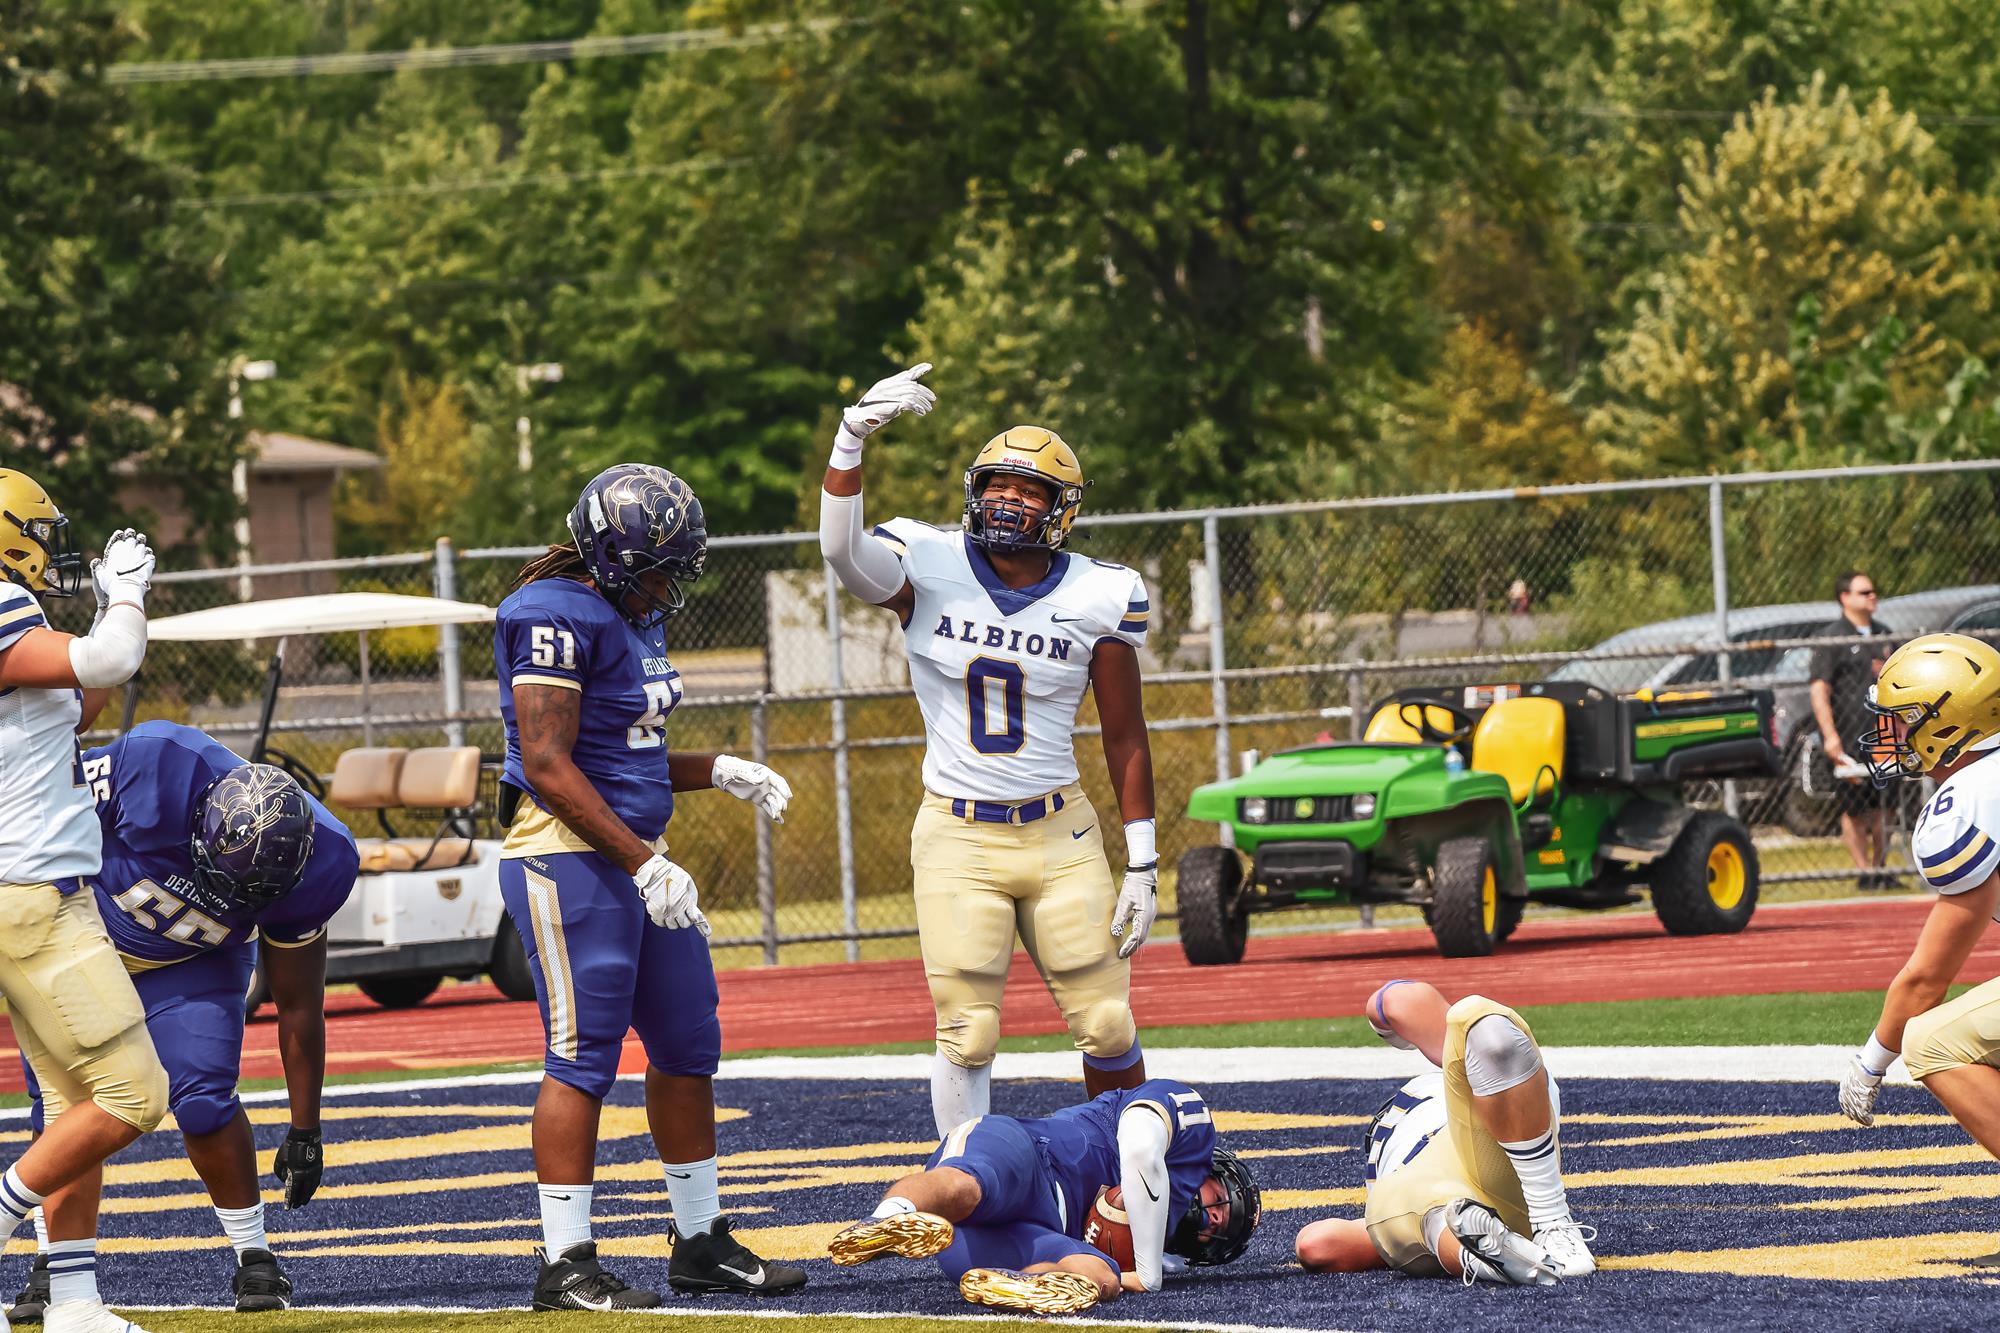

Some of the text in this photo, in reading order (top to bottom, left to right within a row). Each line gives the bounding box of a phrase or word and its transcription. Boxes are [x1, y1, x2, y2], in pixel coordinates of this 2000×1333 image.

[1003, 457, 1033, 468] Riddell
[531, 626, 577, 670] 51
[934, 615, 1073, 661] ALBION
[641, 656, 674, 677] DEFIANC
[964, 653, 1028, 757] 0
[1167, 1088, 1212, 1131] 11
